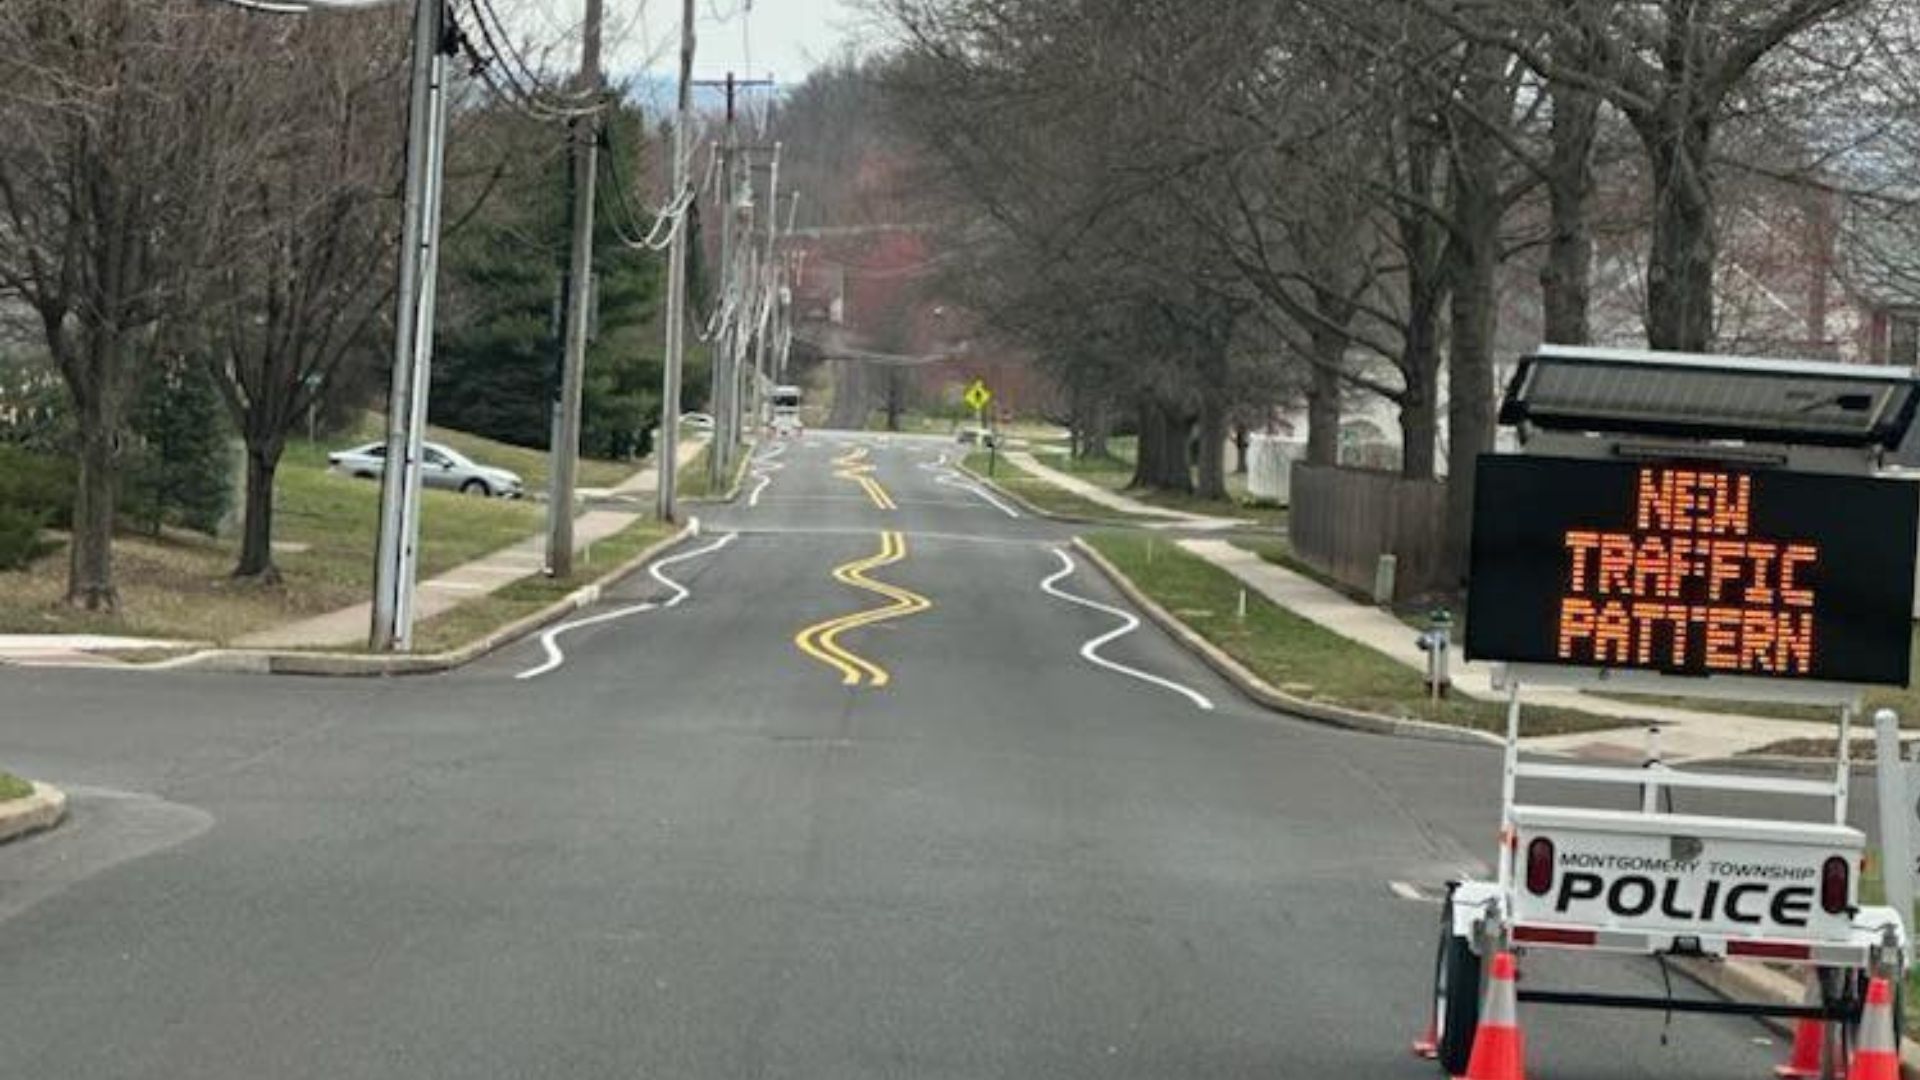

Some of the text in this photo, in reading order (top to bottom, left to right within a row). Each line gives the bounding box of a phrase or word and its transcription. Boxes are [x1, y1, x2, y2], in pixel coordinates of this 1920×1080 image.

[1637, 469, 1751, 534] NEW
[1565, 531, 1817, 606] TRAFFIC
[1558, 598, 1813, 672] PATTERN
[1555, 872, 1815, 927] POLICE
[1559, 853, 1816, 881] MONTGOMERY TOWNSHIP
